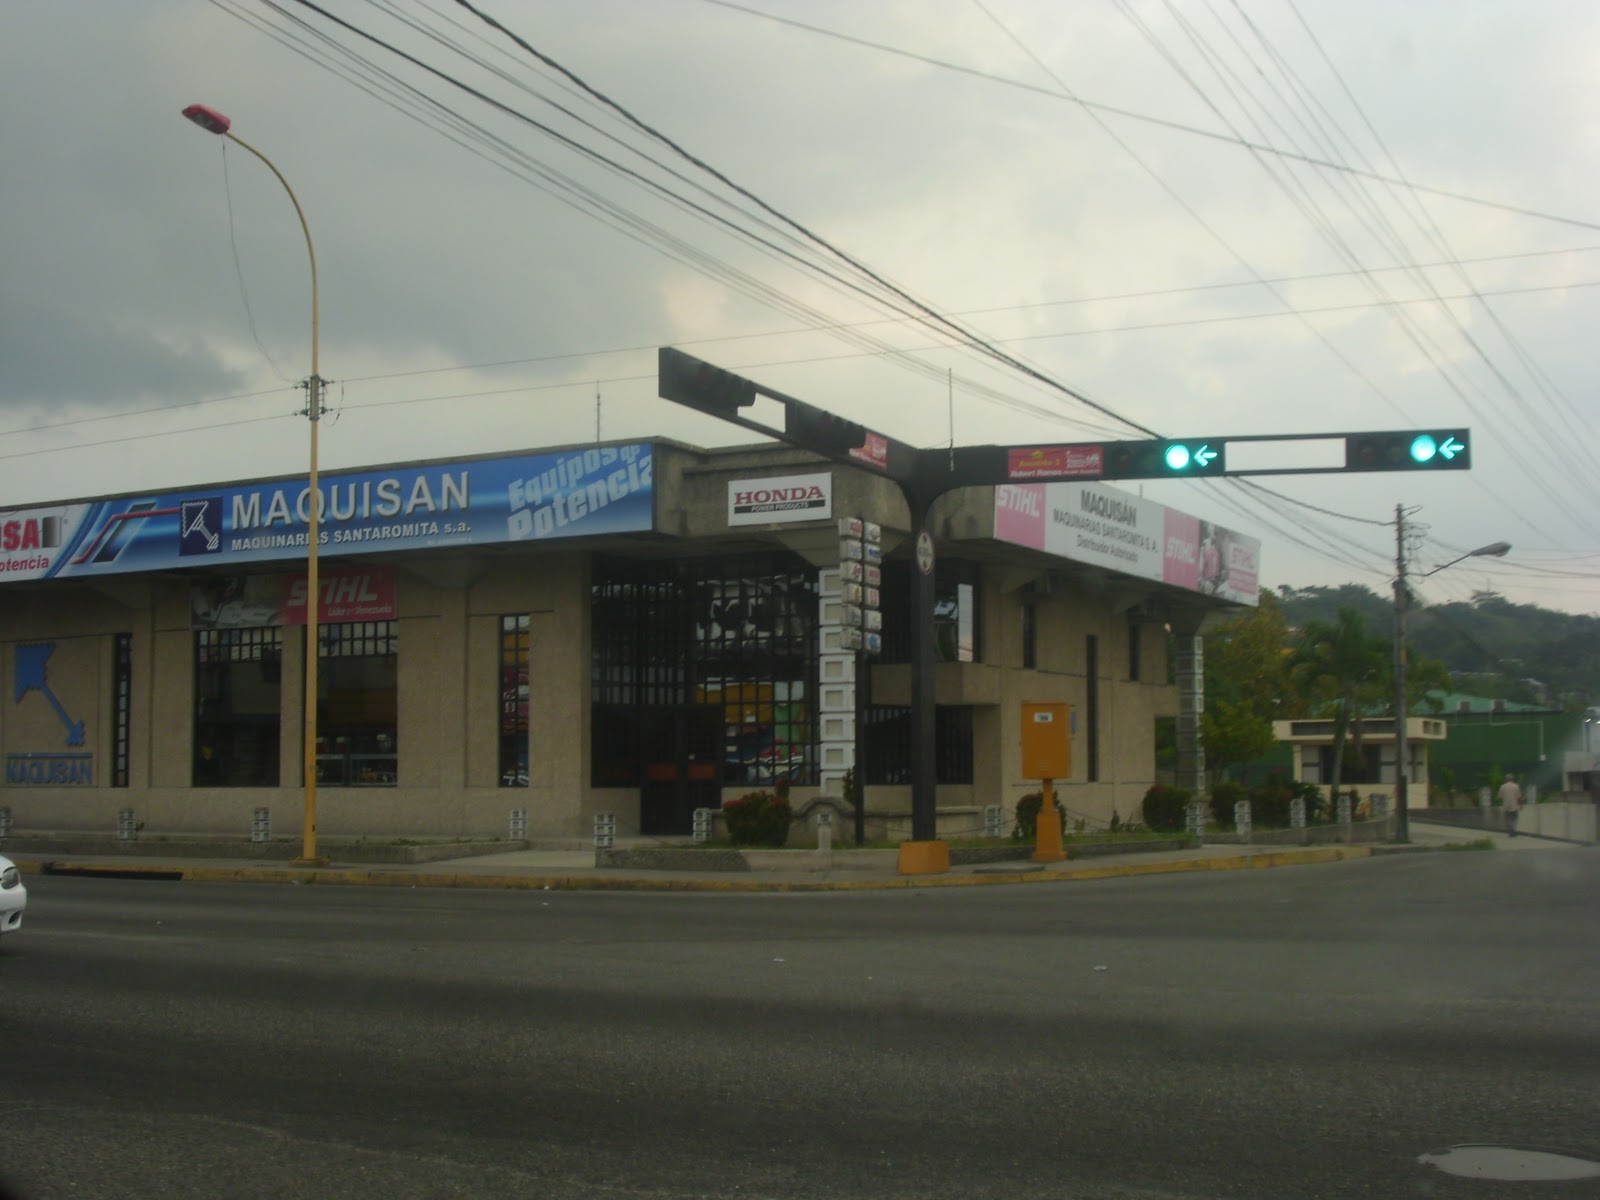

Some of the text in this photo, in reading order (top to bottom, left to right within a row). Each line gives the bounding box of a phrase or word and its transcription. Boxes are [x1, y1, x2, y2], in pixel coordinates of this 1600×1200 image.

[508, 447, 617, 513] Equipos
[734, 486, 825, 505] HONDA
[231, 471, 469, 530] MAQUISAN
[507, 454, 652, 541] Potencia
[996, 484, 1041, 518] STIHL
[231, 530, 329, 552] MAQUINARIS
[334, 520, 439, 544] SANTAROMITA
[1166, 538, 1196, 564] STIHL
